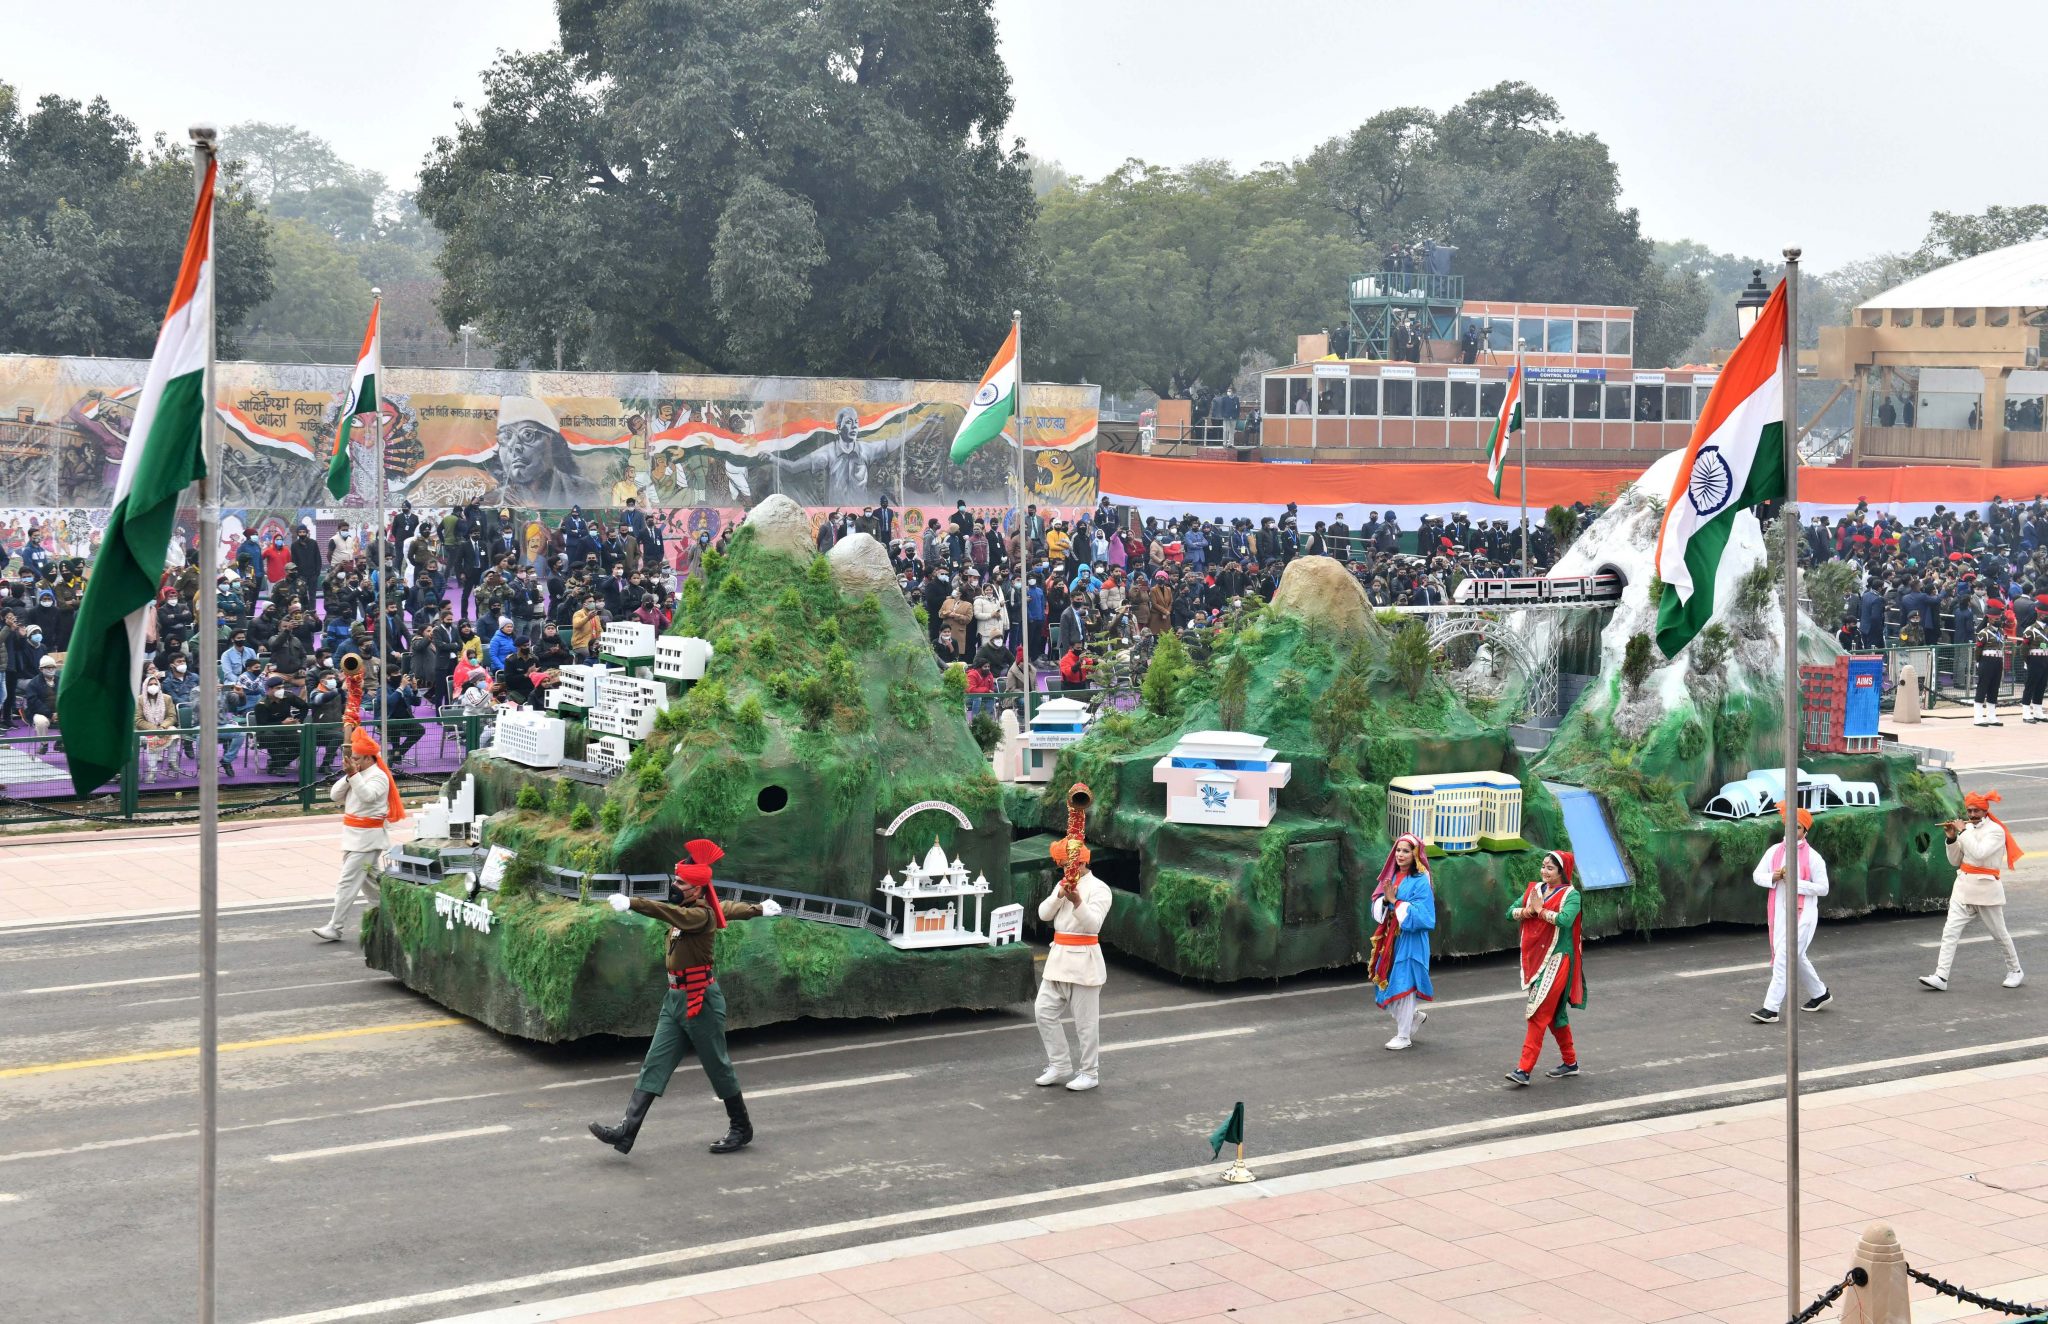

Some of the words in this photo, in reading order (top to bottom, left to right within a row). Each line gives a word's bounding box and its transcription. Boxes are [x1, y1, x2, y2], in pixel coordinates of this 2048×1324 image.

[1856, 677, 1873, 685] AIIMS
[888, 820, 900, 834] SHRI
[900, 809, 914, 822] MATA
[940, 802, 952, 811] DEVI
